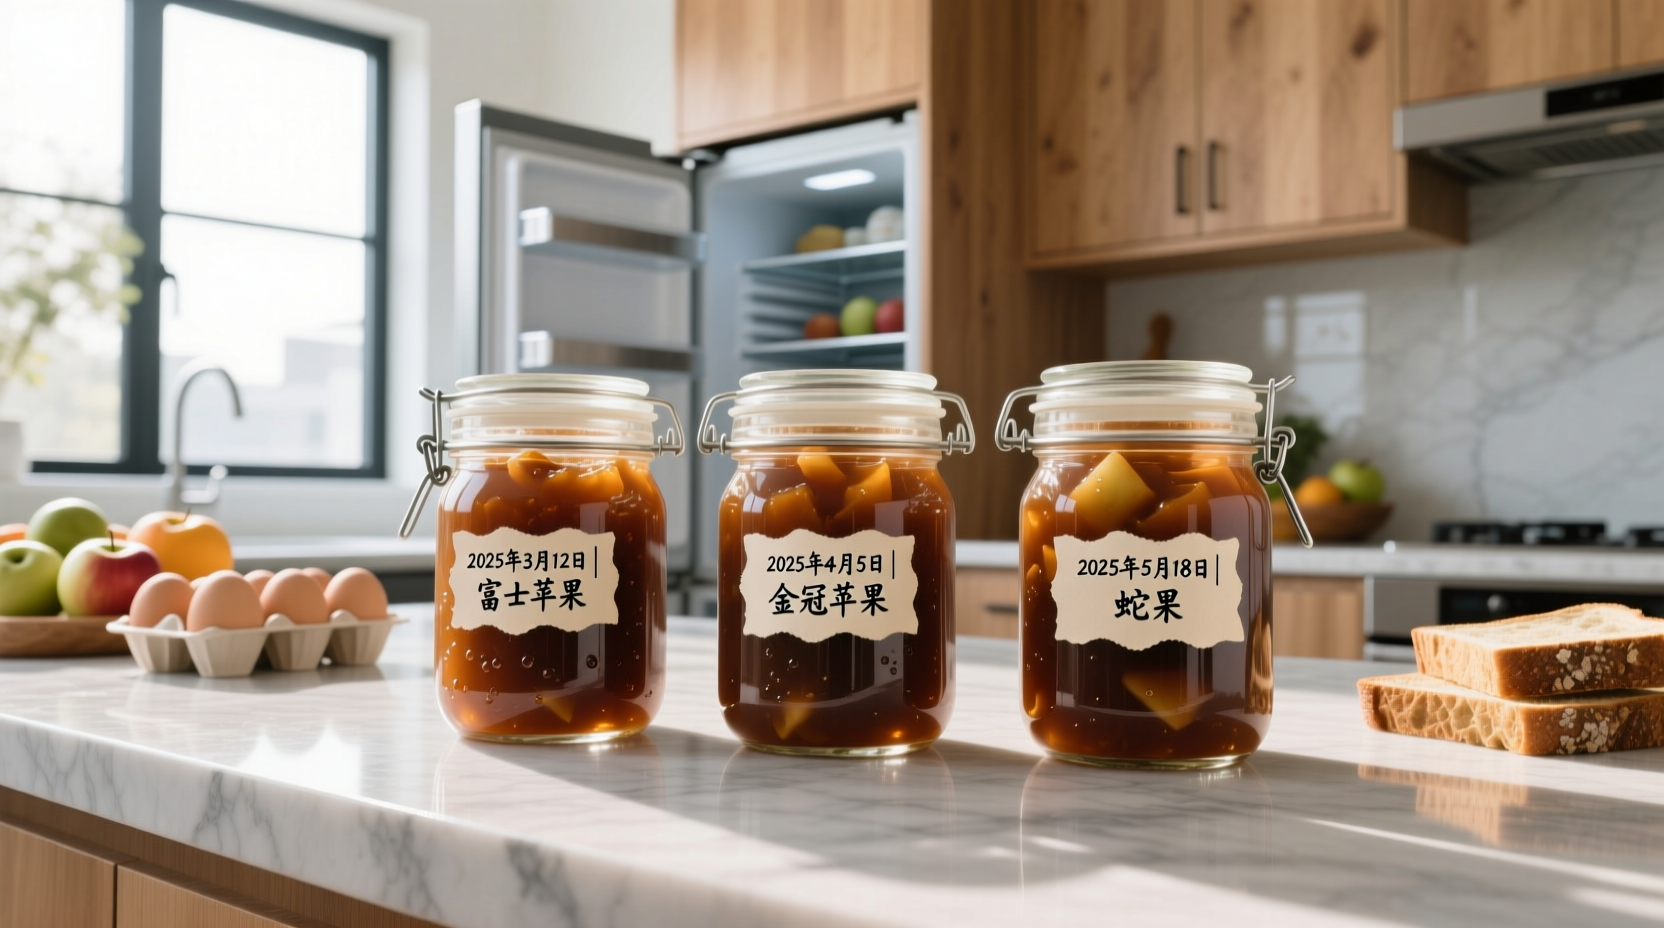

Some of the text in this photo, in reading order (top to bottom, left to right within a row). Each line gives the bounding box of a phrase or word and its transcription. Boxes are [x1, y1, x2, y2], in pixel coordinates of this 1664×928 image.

[467, 548, 585, 573] 2025年3月12日
[766, 550, 882, 576] 2025年4月5日
[1077, 555, 1208, 580] 2025年5月18日
[478, 577, 587, 612] 富士苹果
[769, 581, 889, 618] 金冠苹果
[1114, 588, 1183, 624] 蛇果
